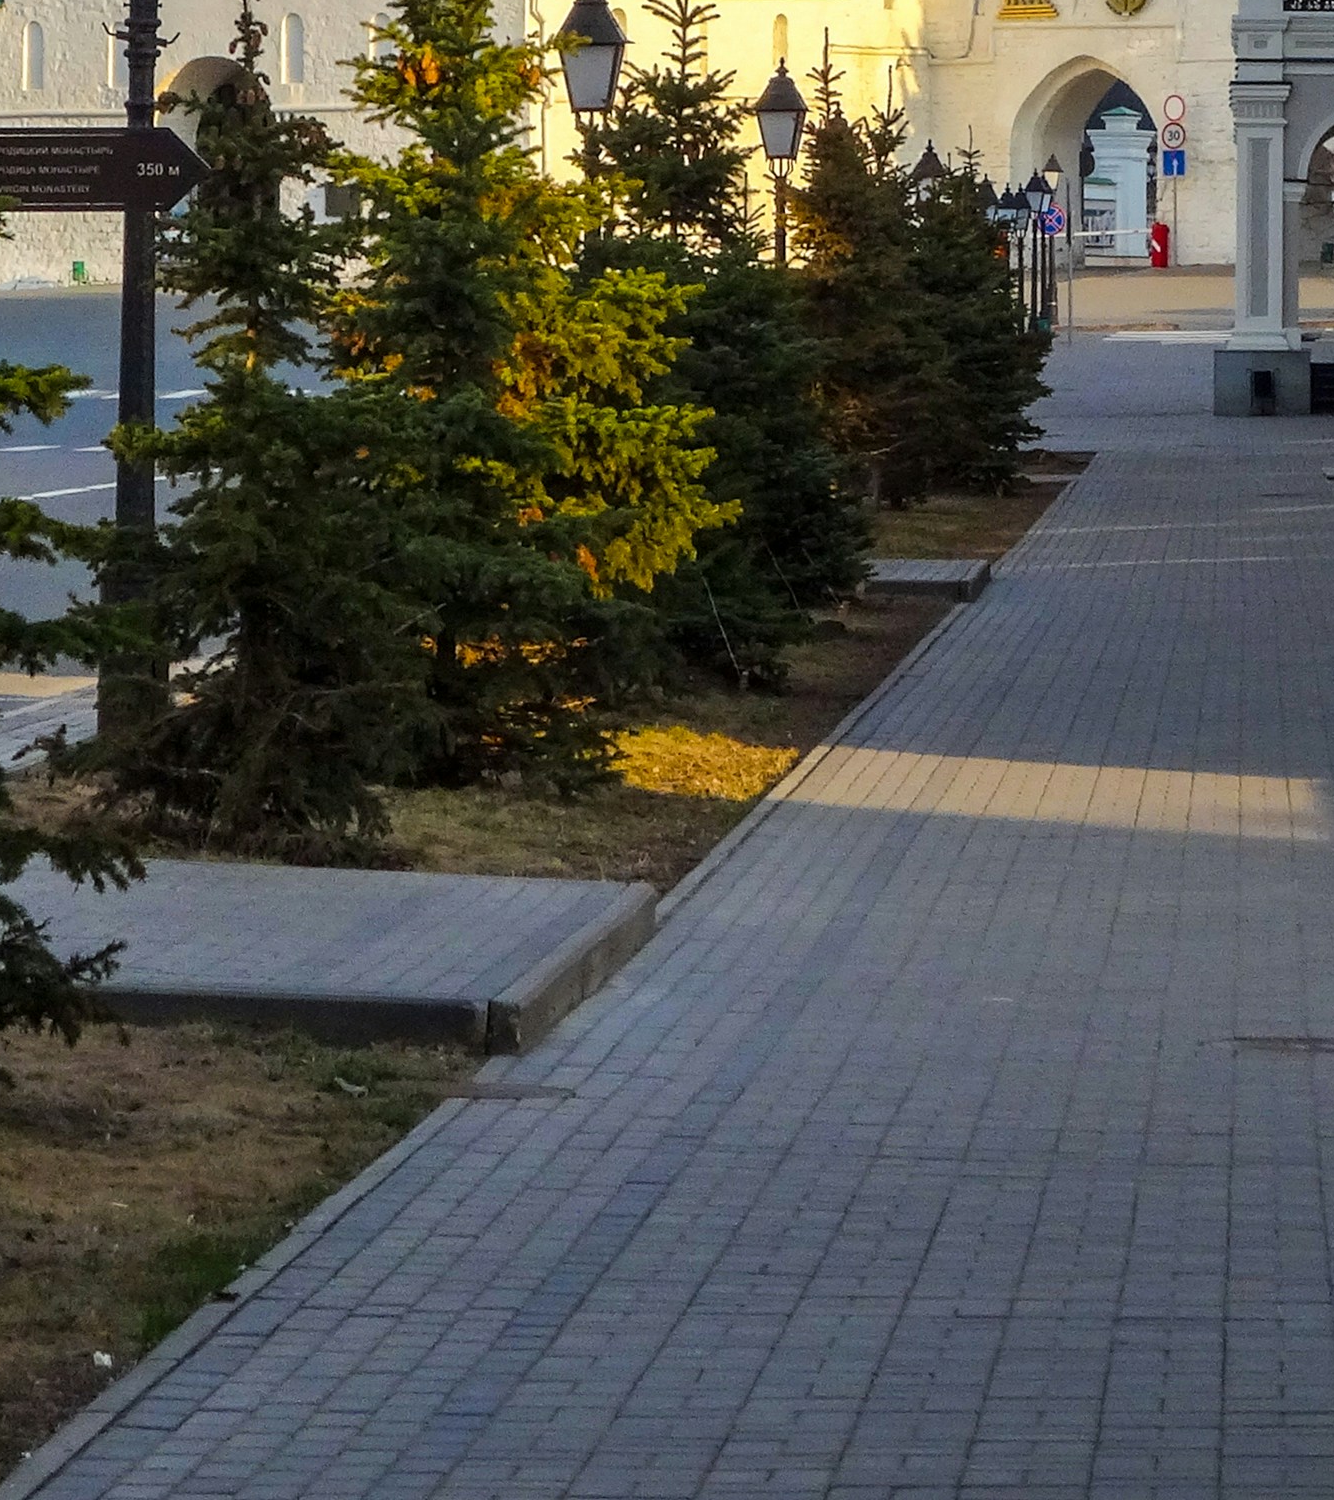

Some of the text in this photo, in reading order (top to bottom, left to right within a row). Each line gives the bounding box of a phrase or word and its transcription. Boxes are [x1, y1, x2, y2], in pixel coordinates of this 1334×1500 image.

[1167, 130, 1180, 141] 30
[137, 162, 164, 176] 350
[31, 184, 91, 193] MONASTERY
